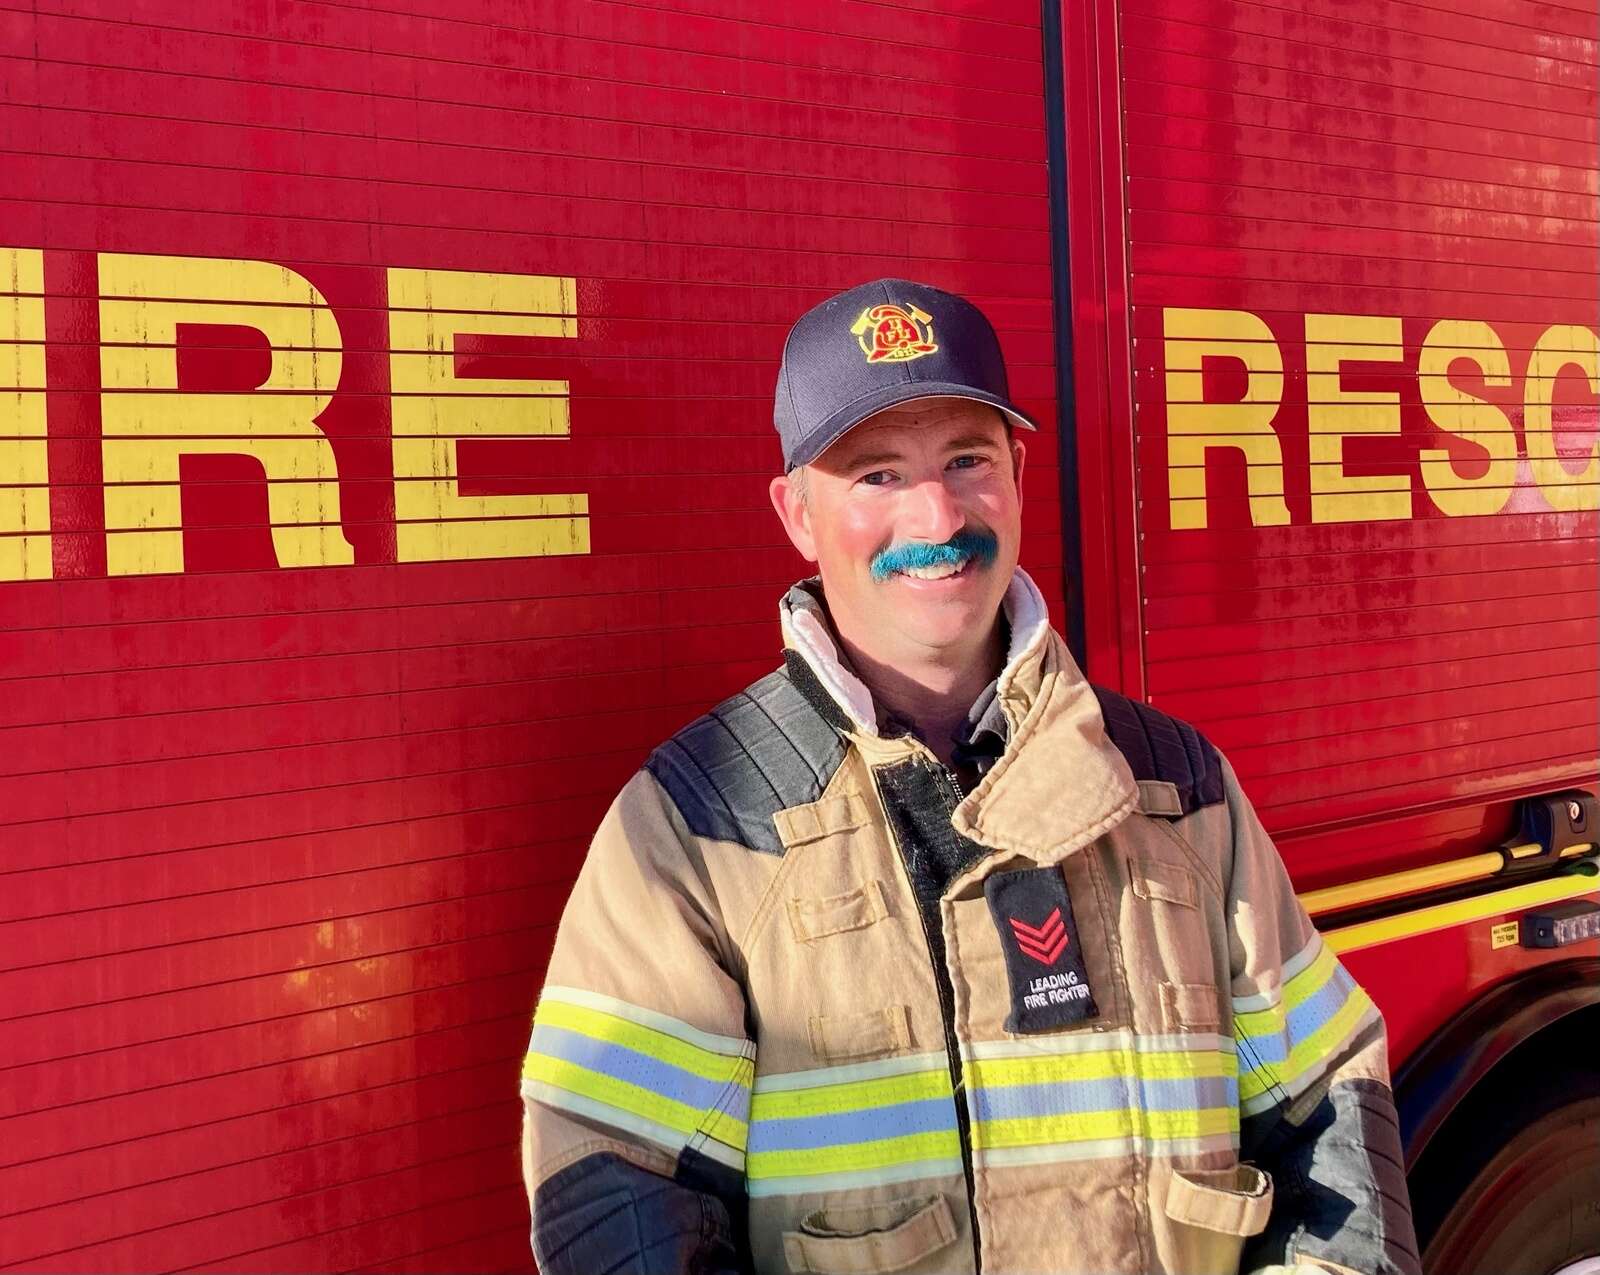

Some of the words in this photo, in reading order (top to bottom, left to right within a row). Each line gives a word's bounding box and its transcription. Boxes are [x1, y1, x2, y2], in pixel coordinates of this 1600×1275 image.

[1163, 307, 1600, 530] RESC
[1029, 971, 1078, 994] LEADING
[1023, 992, 1049, 1010] FIRE
[1048, 983, 1090, 1005] FIGHTER
